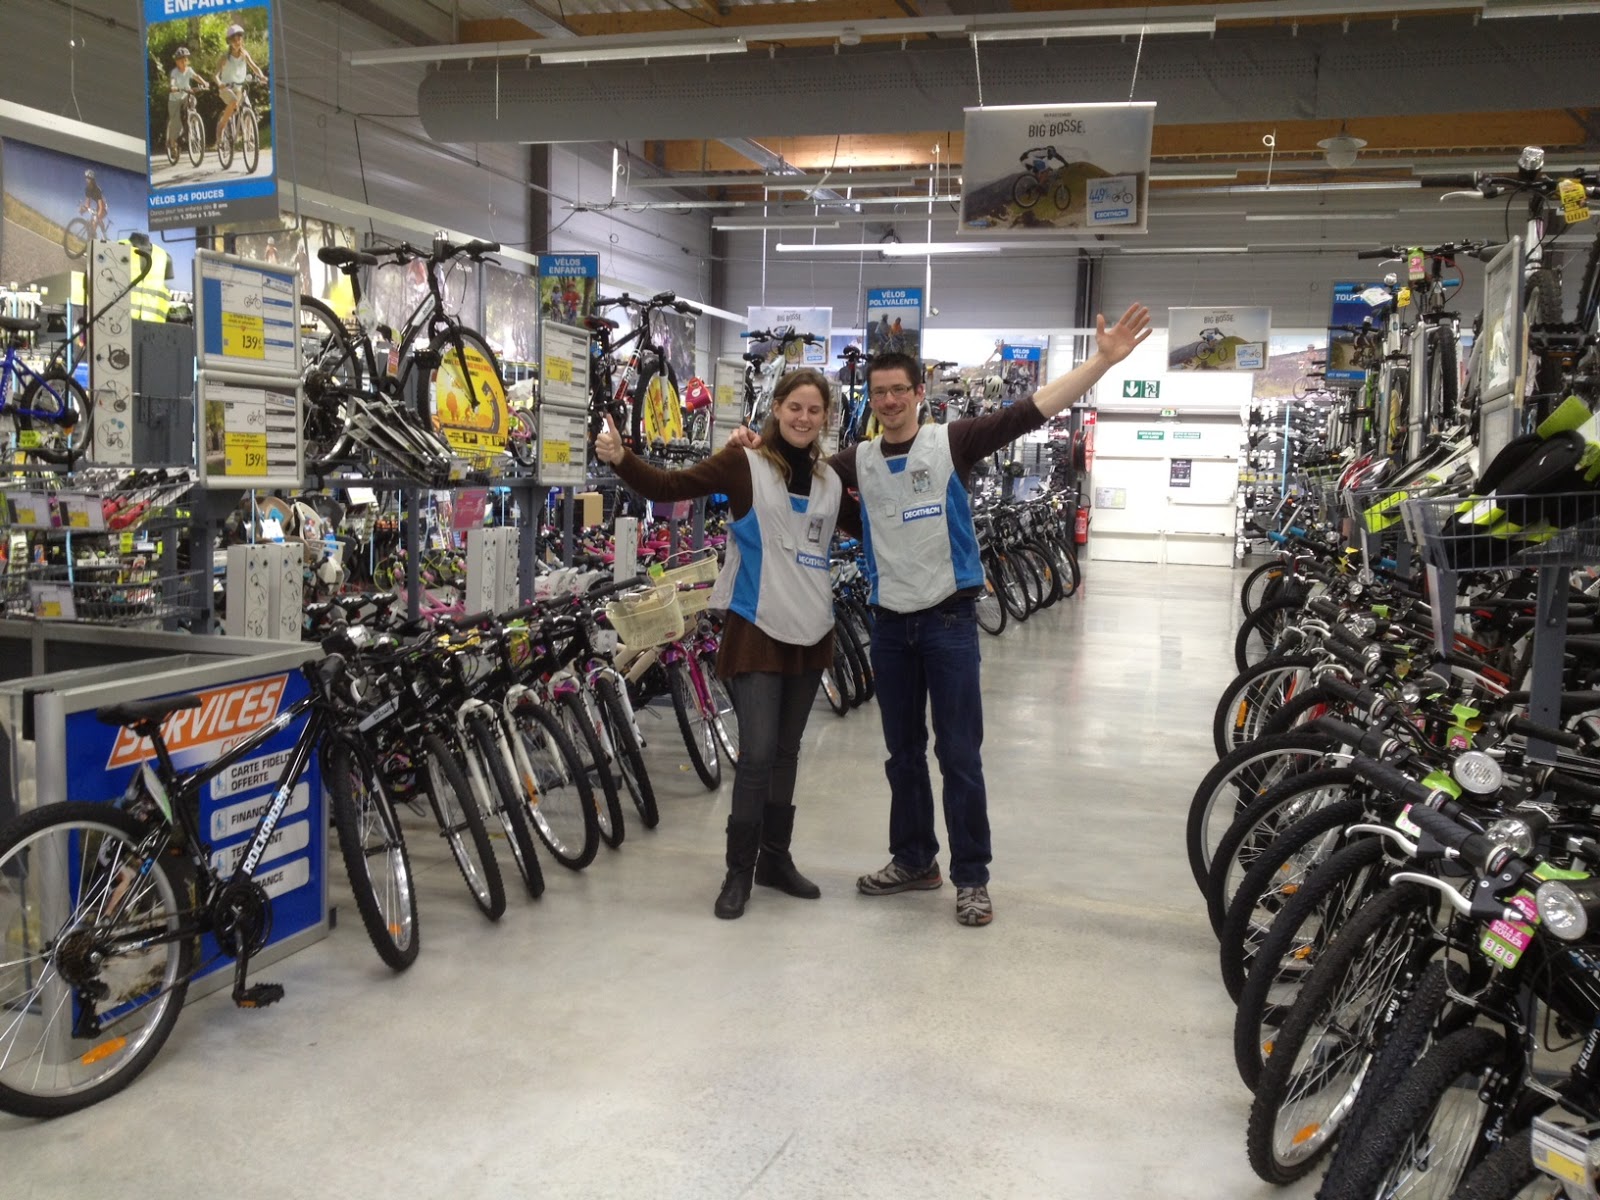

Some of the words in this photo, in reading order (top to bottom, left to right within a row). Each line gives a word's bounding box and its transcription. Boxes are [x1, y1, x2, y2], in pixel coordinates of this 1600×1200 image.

[1028, 123, 1046, 138] BIG
[149, 194, 176, 206] VÉLOS
[177, 193, 189, 203] 24
[190, 189, 225, 201] POUCES
[554, 257, 581, 266] VÉLOS
[548, 266, 587, 275] ENFANTS
[869, 297, 919, 306] POLYVALENTS
[881, 290, 906, 298] VÉLOS
[903, 505, 941, 520] DECATHLON
[231, 761, 260, 779] CARTE
[231, 770, 269, 791] OFFERTE
[242, 783, 291, 876] ROCKRIDER
[1491, 924, 1524, 949] ROULER
